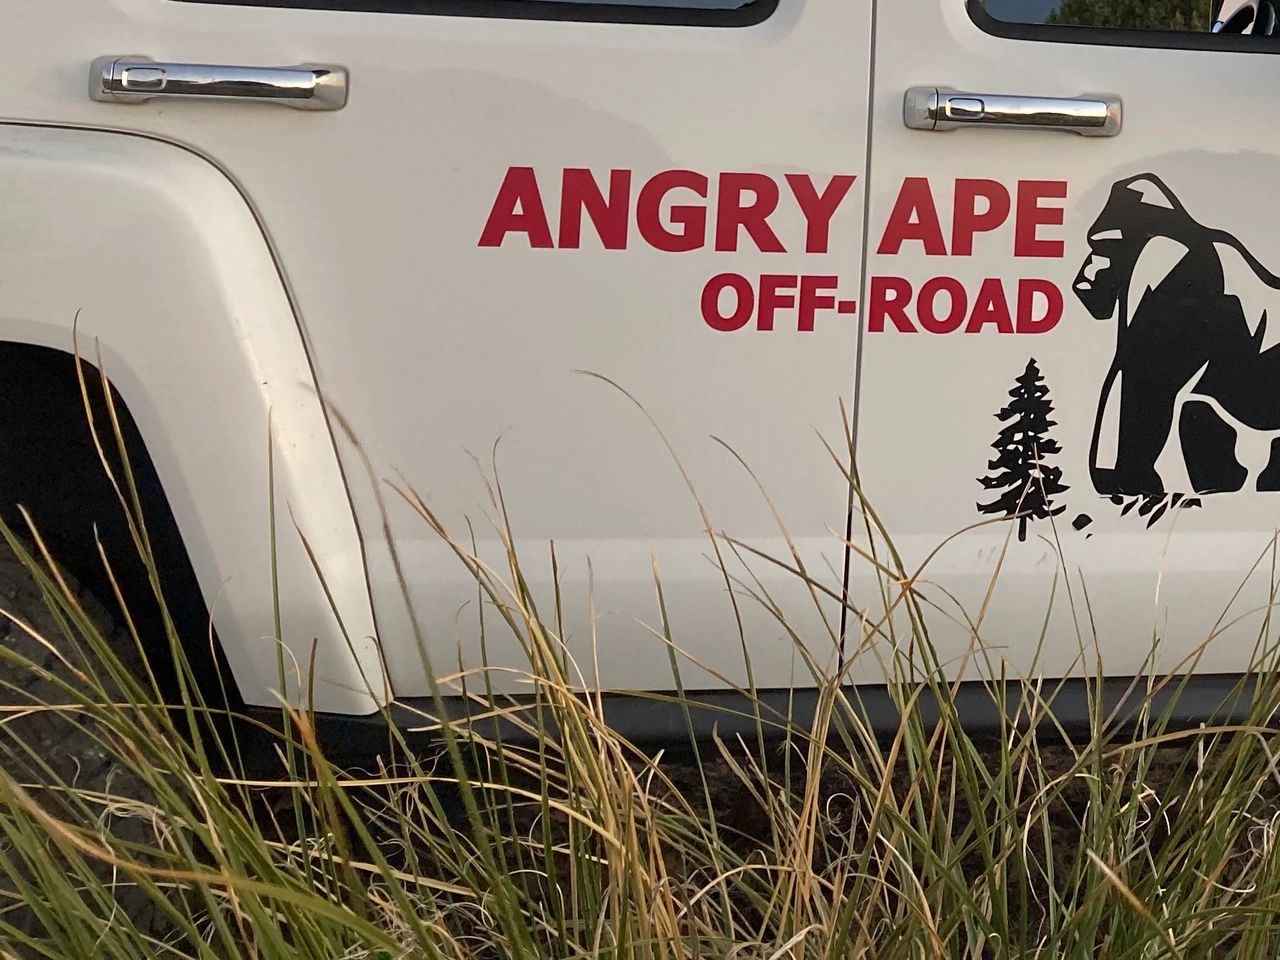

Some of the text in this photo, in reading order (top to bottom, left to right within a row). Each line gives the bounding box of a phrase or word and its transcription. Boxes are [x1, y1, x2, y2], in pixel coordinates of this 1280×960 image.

[478, 166, 1068, 258] ANGRY APE
[700, 272, 1065, 335] OFF-ROAD
